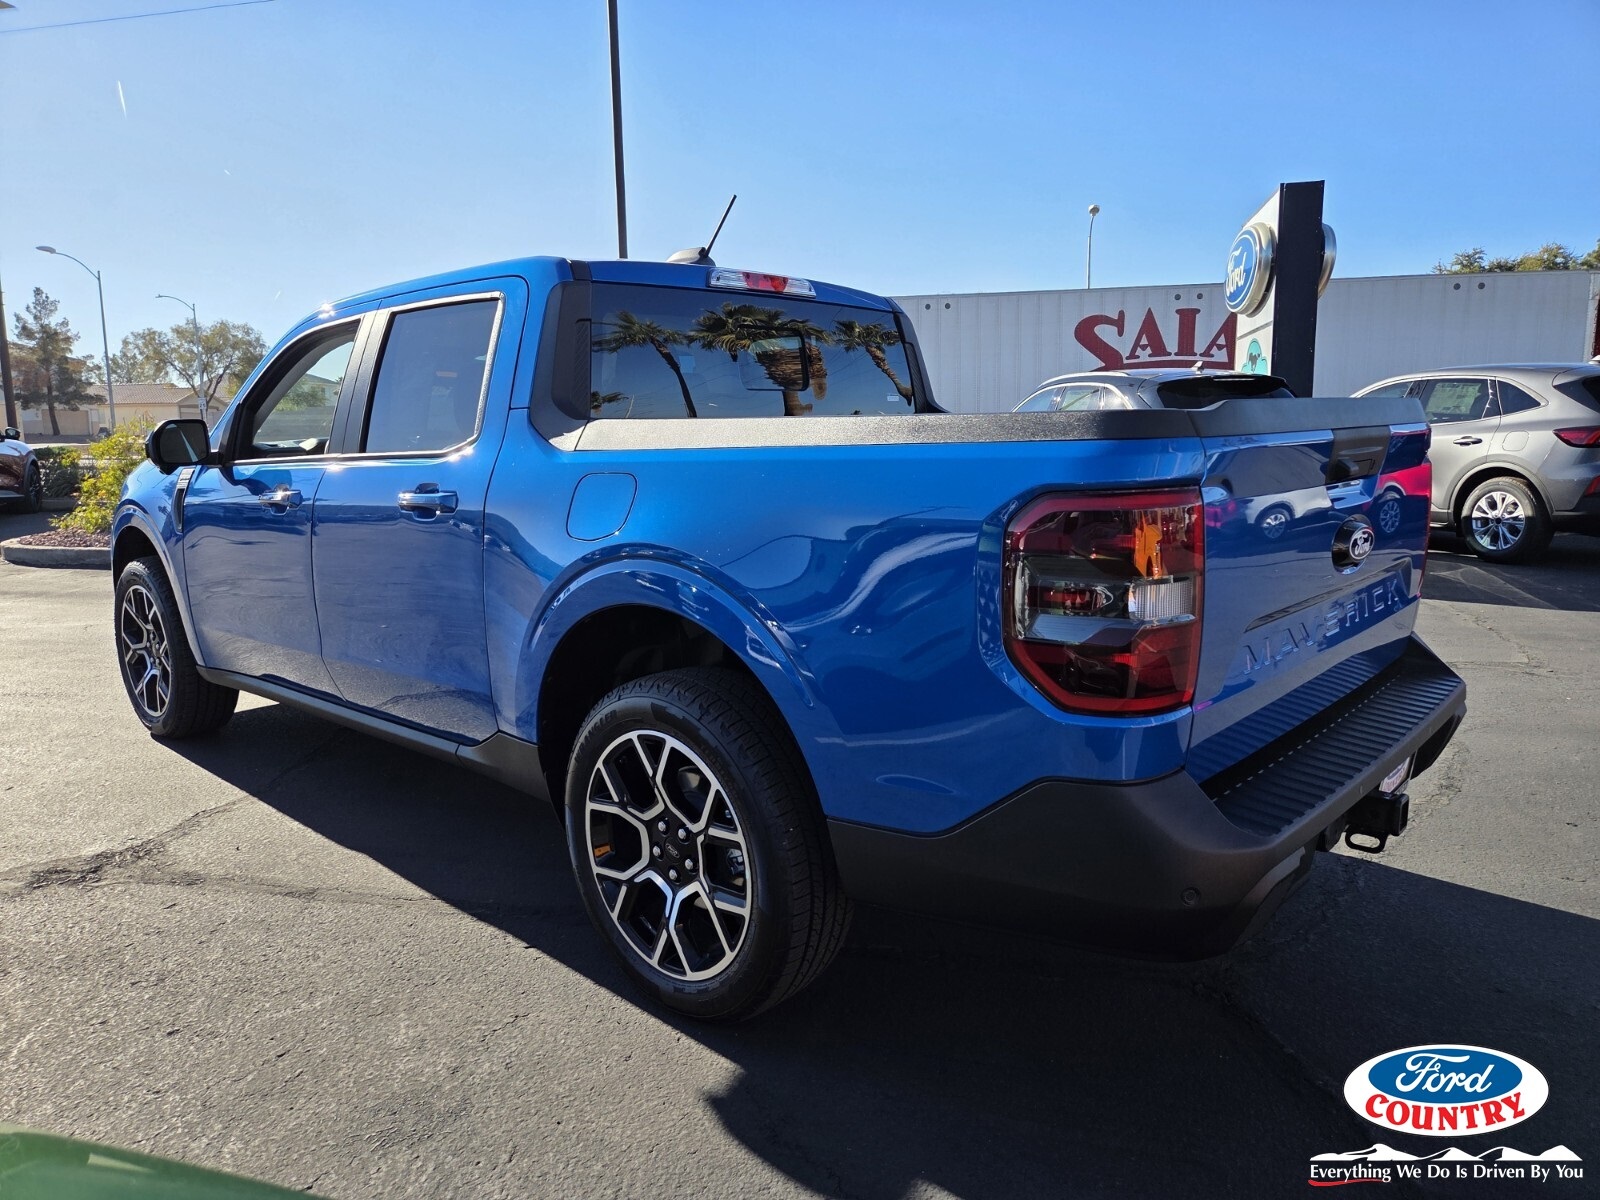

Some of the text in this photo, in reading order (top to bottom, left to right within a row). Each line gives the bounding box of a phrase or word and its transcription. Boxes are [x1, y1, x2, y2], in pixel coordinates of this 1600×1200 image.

[1226, 246, 1247, 296] Ford
[1074, 307, 1238, 372] SAIA
[1353, 531, 1372, 556] Ford
[1243, 579, 1400, 675] MAVERICK
